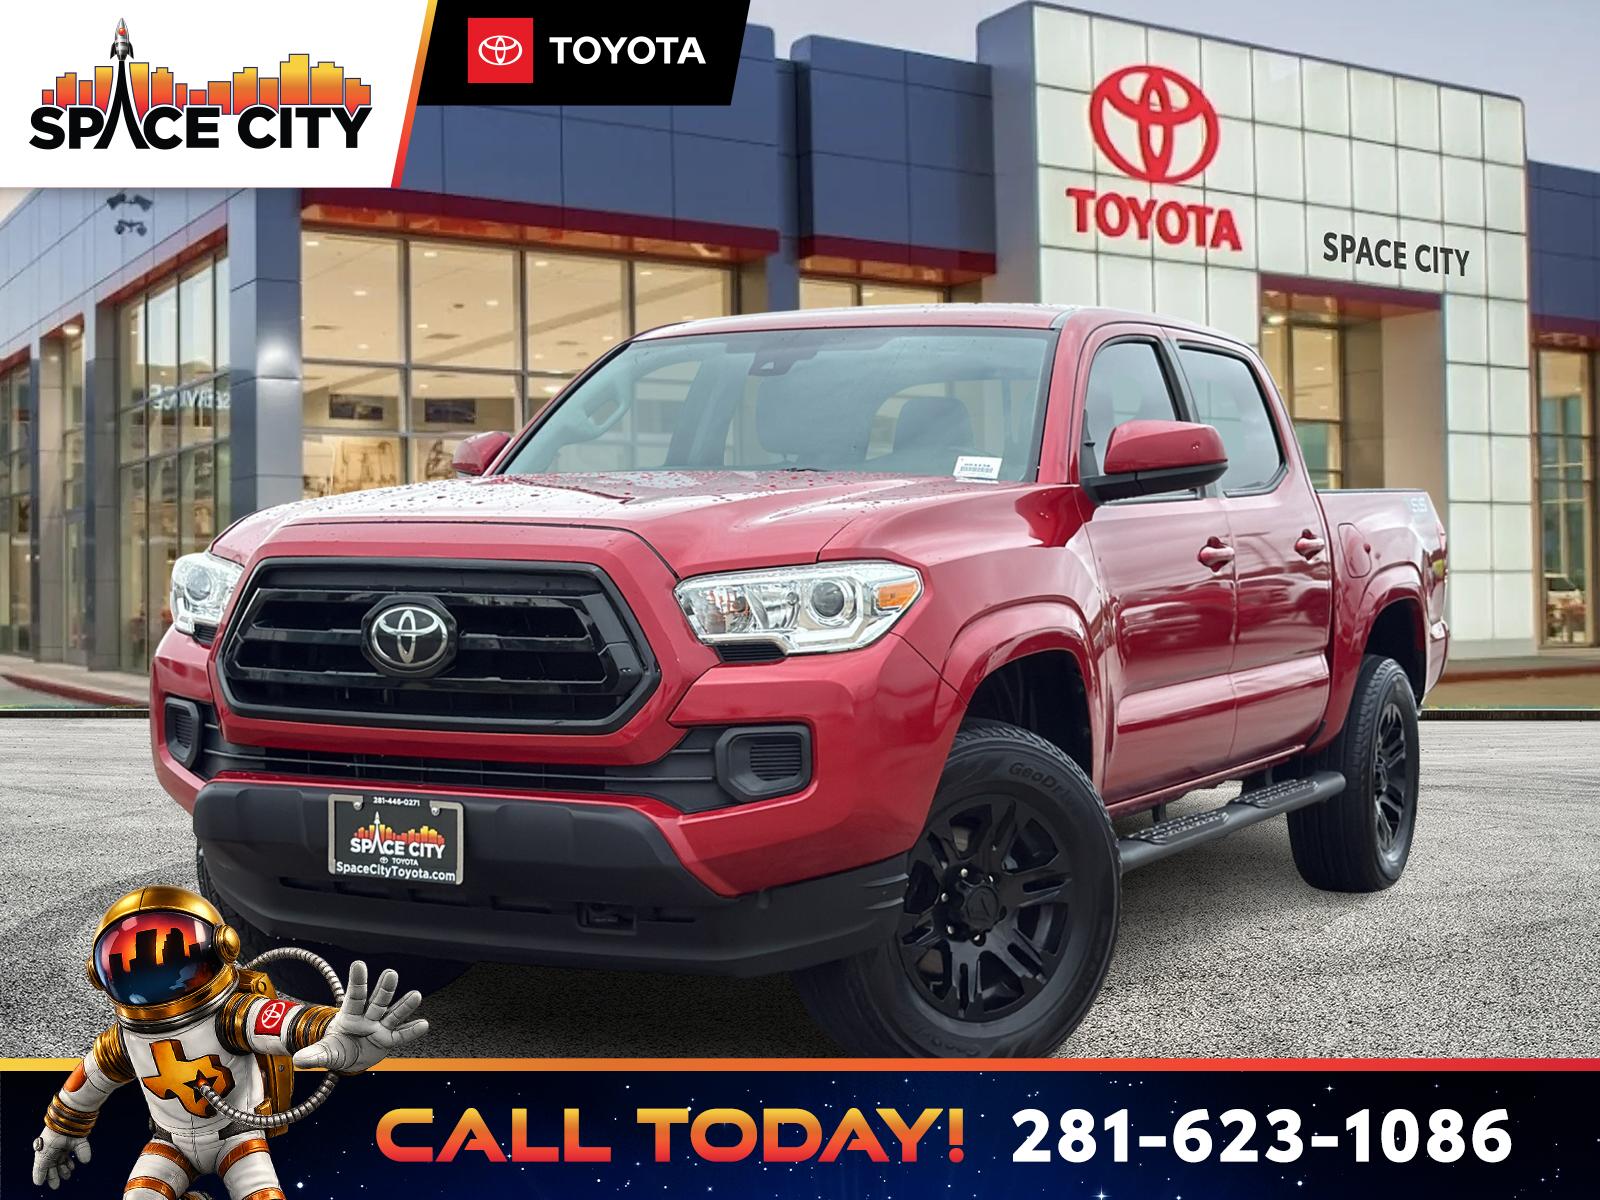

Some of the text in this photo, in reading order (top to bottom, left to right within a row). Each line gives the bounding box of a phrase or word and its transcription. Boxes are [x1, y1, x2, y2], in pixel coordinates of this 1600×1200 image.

[1066, 187, 1242, 252] TOYOTA
[1322, 231, 1471, 277] SPACE CITY
[350, 837, 446, 859] SPACE CITY
[336, 861, 456, 881] SpaceCityToyota.com
[391, 857, 419, 866] TOYOTA
